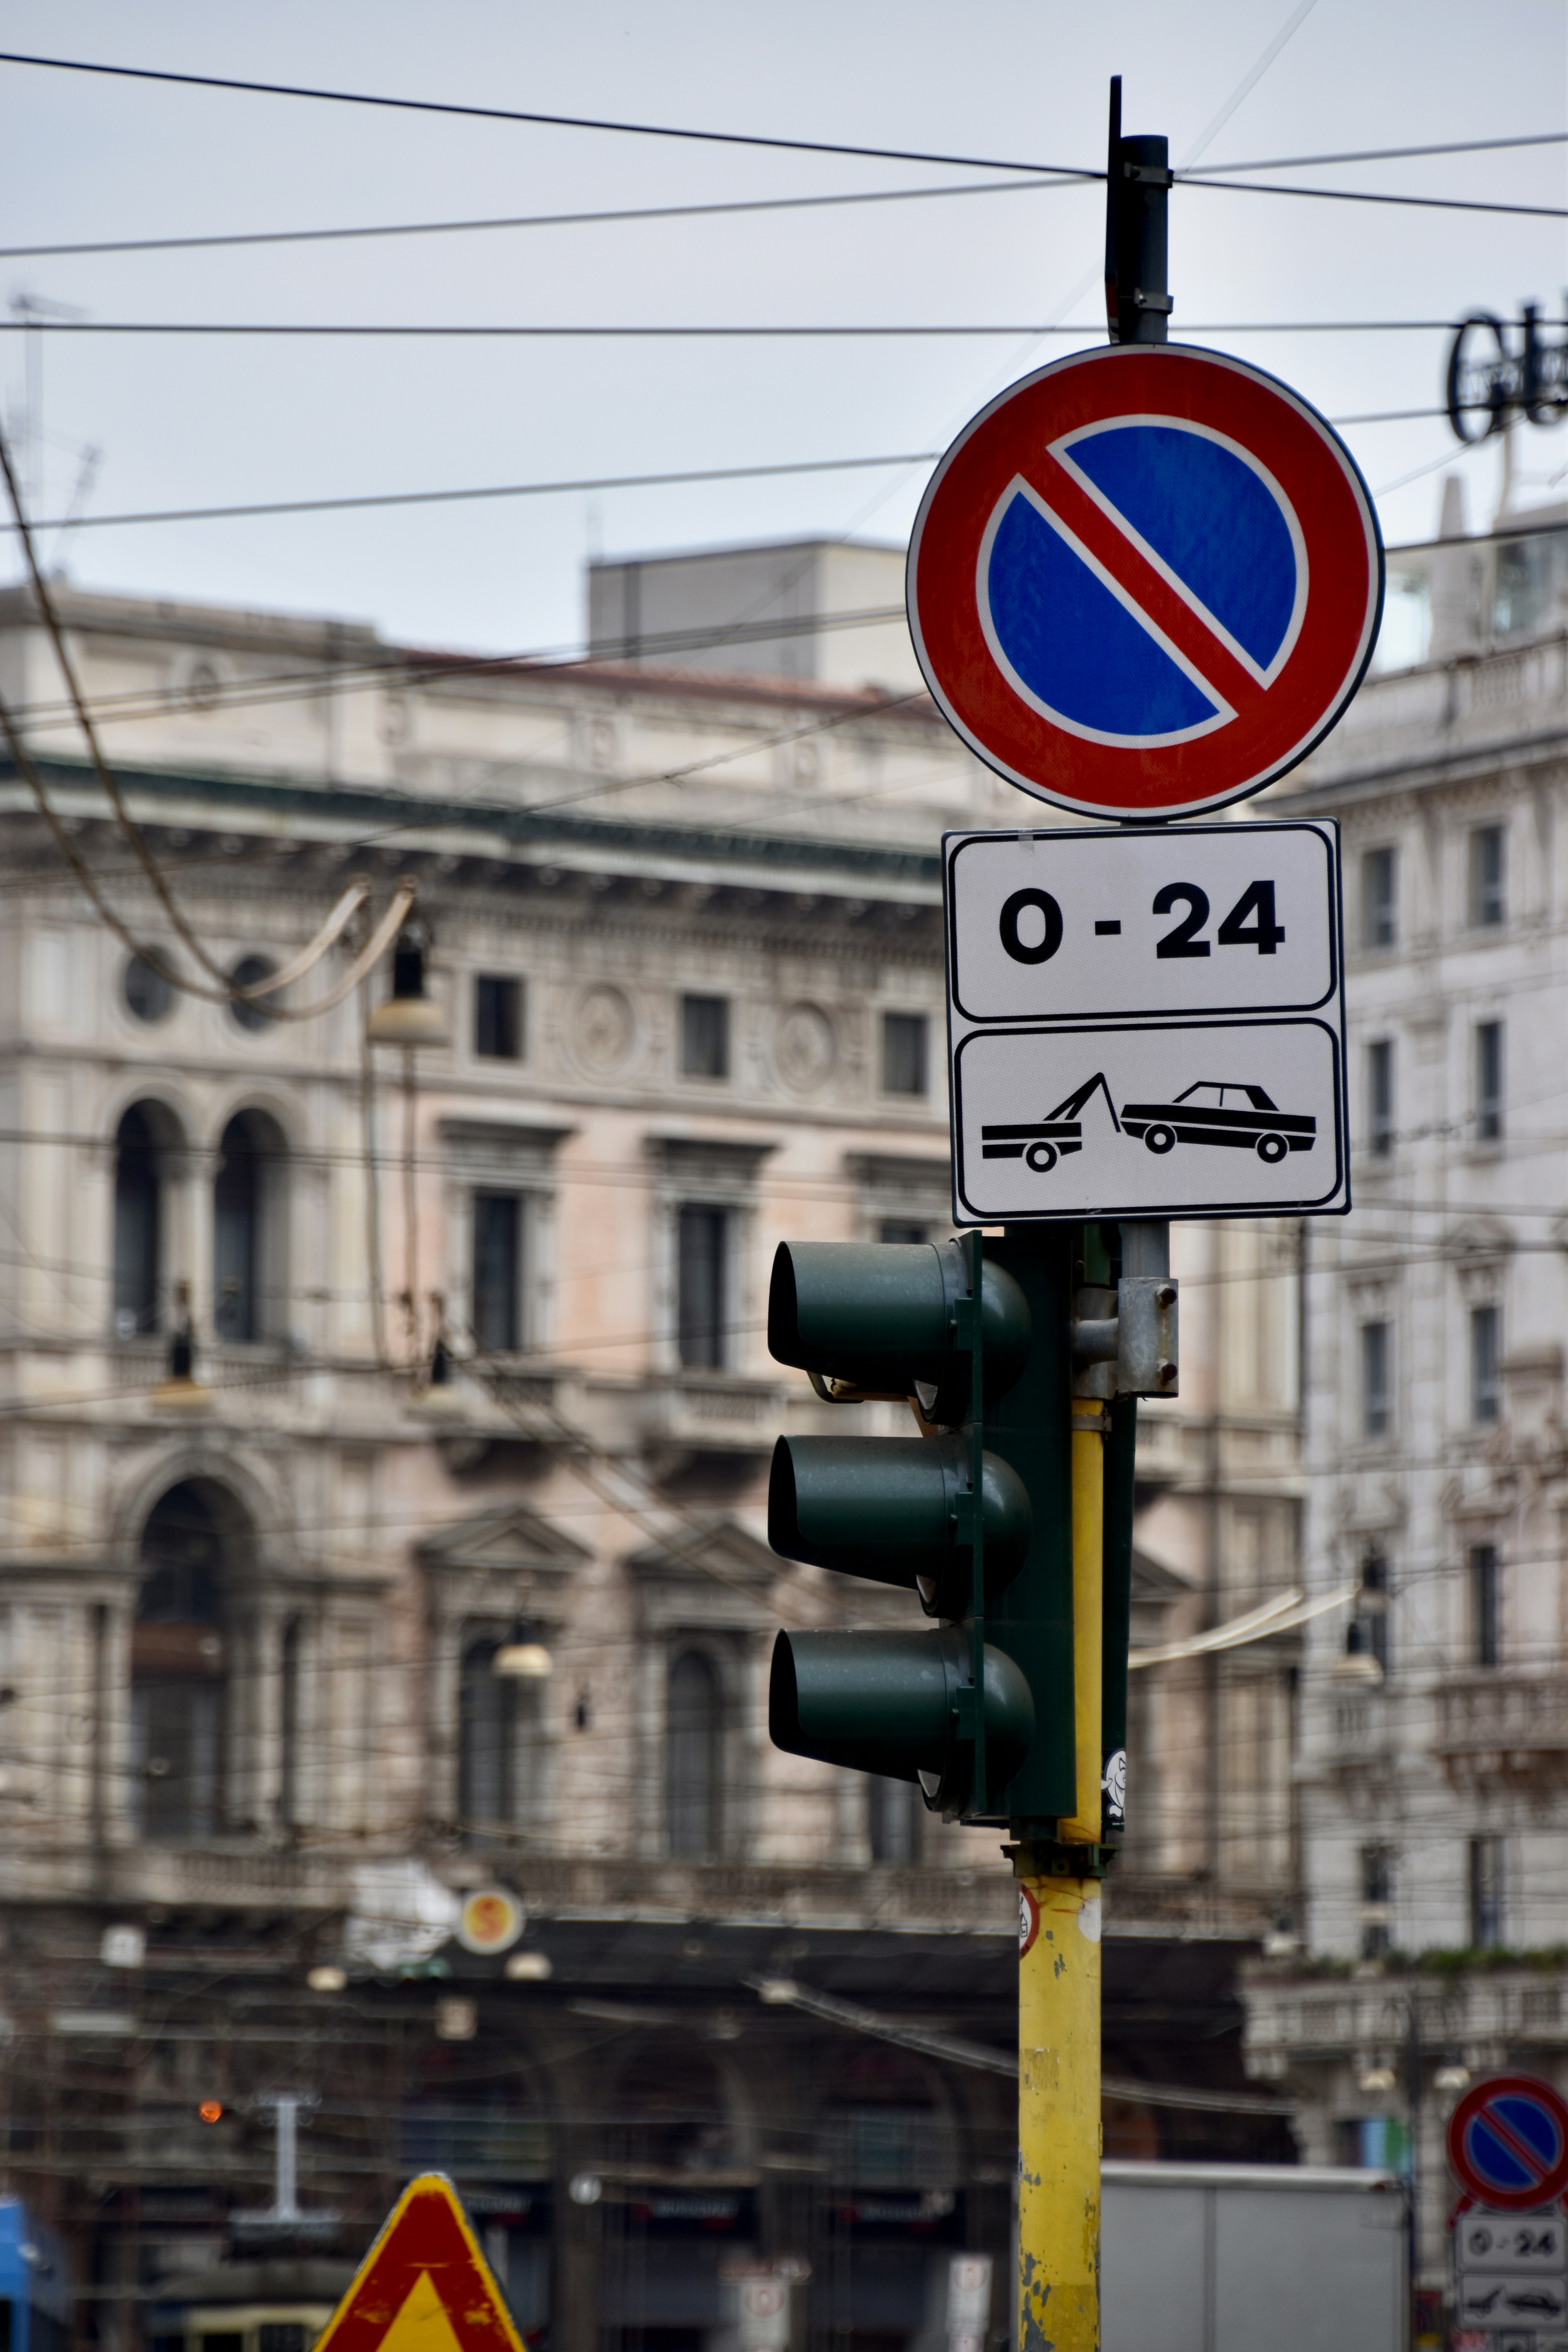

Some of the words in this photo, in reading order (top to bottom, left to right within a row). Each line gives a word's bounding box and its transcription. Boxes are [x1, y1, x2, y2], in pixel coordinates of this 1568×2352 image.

[999, 887, 1063, 965] 0
[1094, 920, 1122, 936] -
[1152, 880, 1285, 959] 24
[1468, 2226, 1493, 2256] 0
[1514, 2228, 1557, 2257] 24
